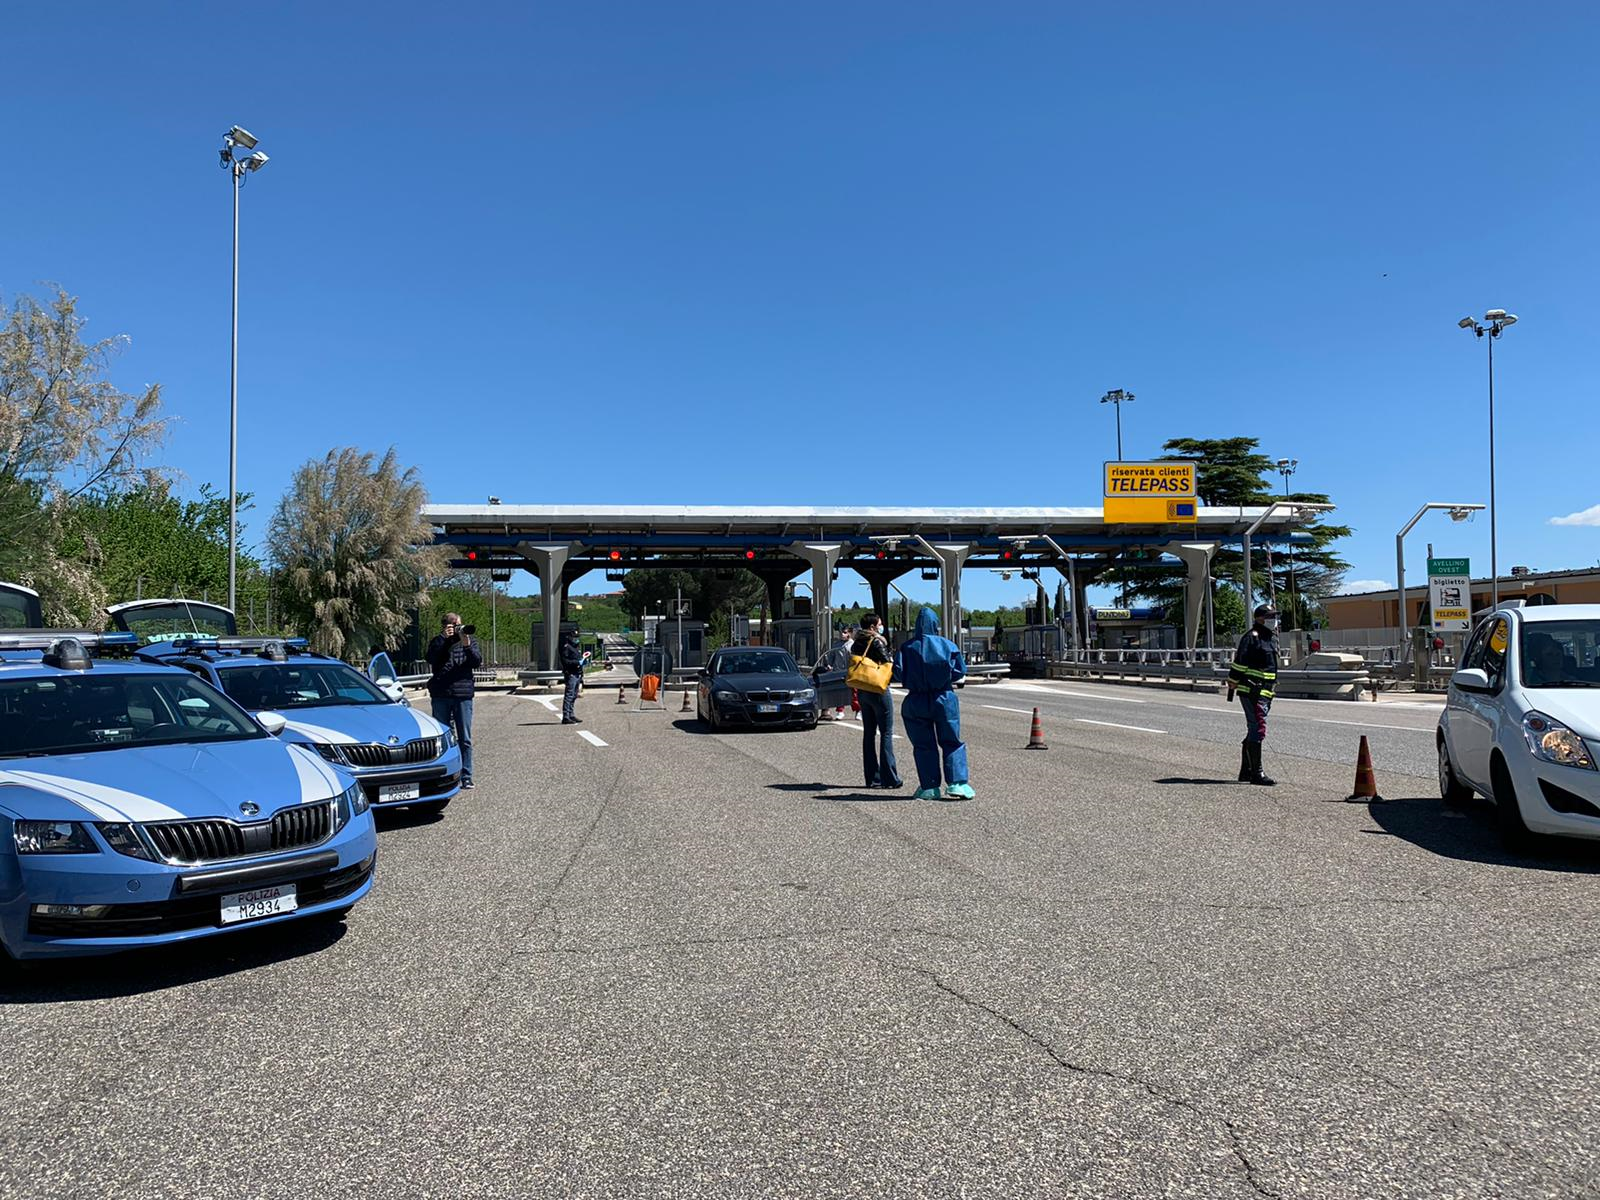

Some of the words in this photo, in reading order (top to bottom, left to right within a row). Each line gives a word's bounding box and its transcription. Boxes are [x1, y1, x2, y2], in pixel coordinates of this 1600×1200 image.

[1112, 468, 1155, 476] riservata
[1159, 468, 1189, 476] clienti
[1111, 478, 1190, 492] TELEPASS
[238, 888, 280, 903] POLIZIA
[240, 899, 280, 918] M2934
